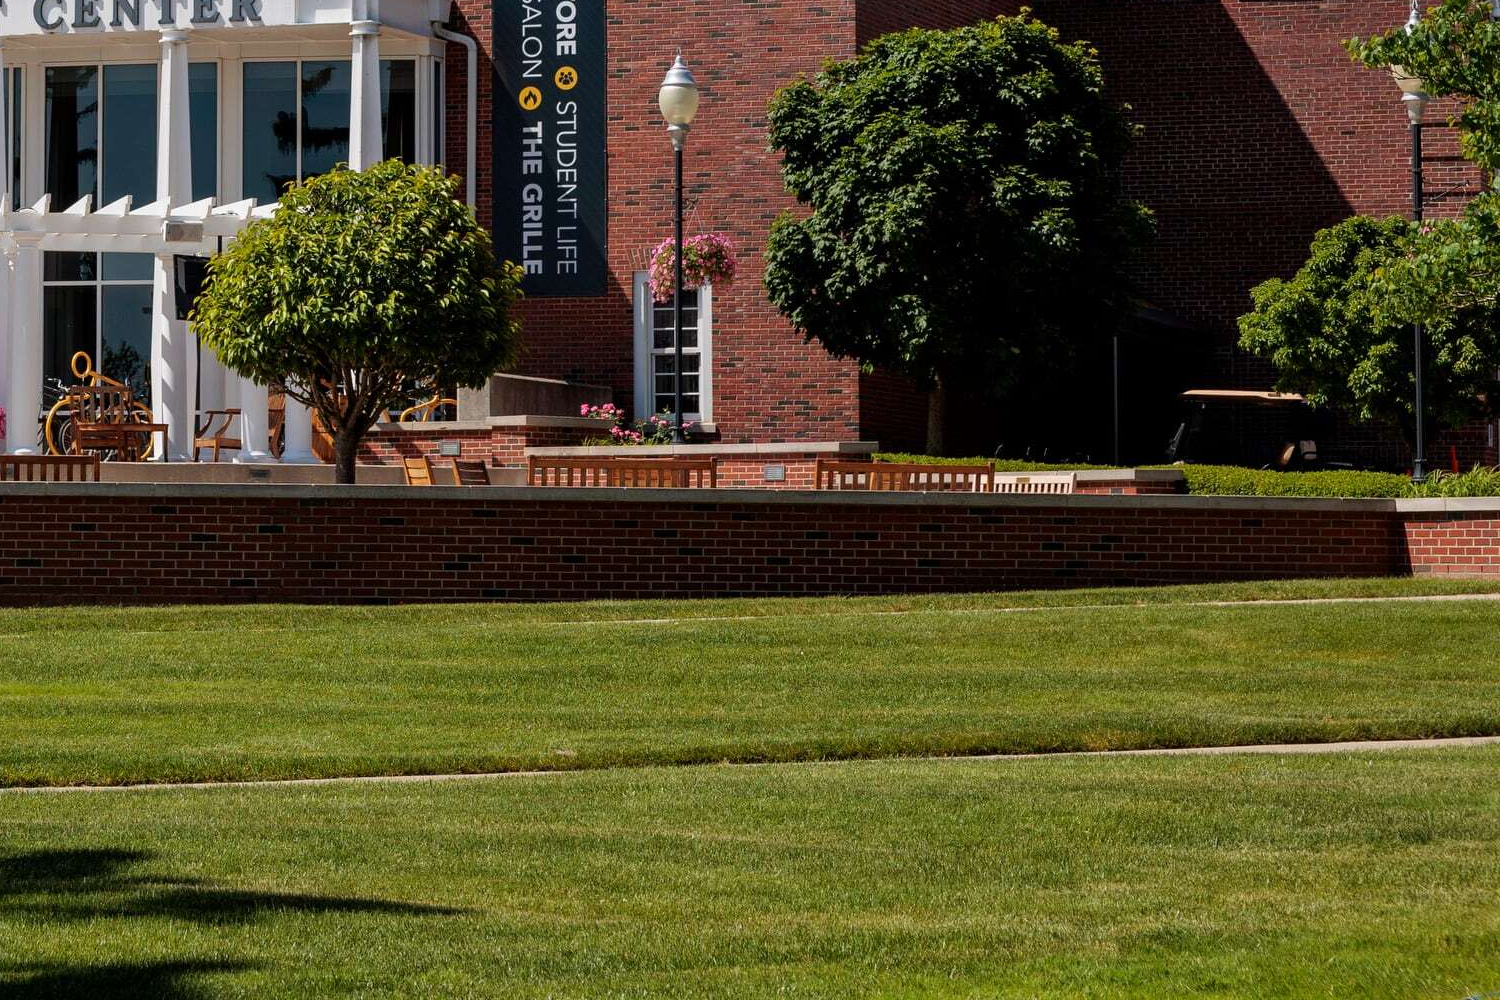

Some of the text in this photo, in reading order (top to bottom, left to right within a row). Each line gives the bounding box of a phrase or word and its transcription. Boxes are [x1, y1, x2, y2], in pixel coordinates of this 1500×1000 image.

[522, 121, 543, 175] THE
[556, 101, 577, 219] STUDENT
[522, 183, 543, 276] GRILLE
[556, 226, 578, 275] LIFE
